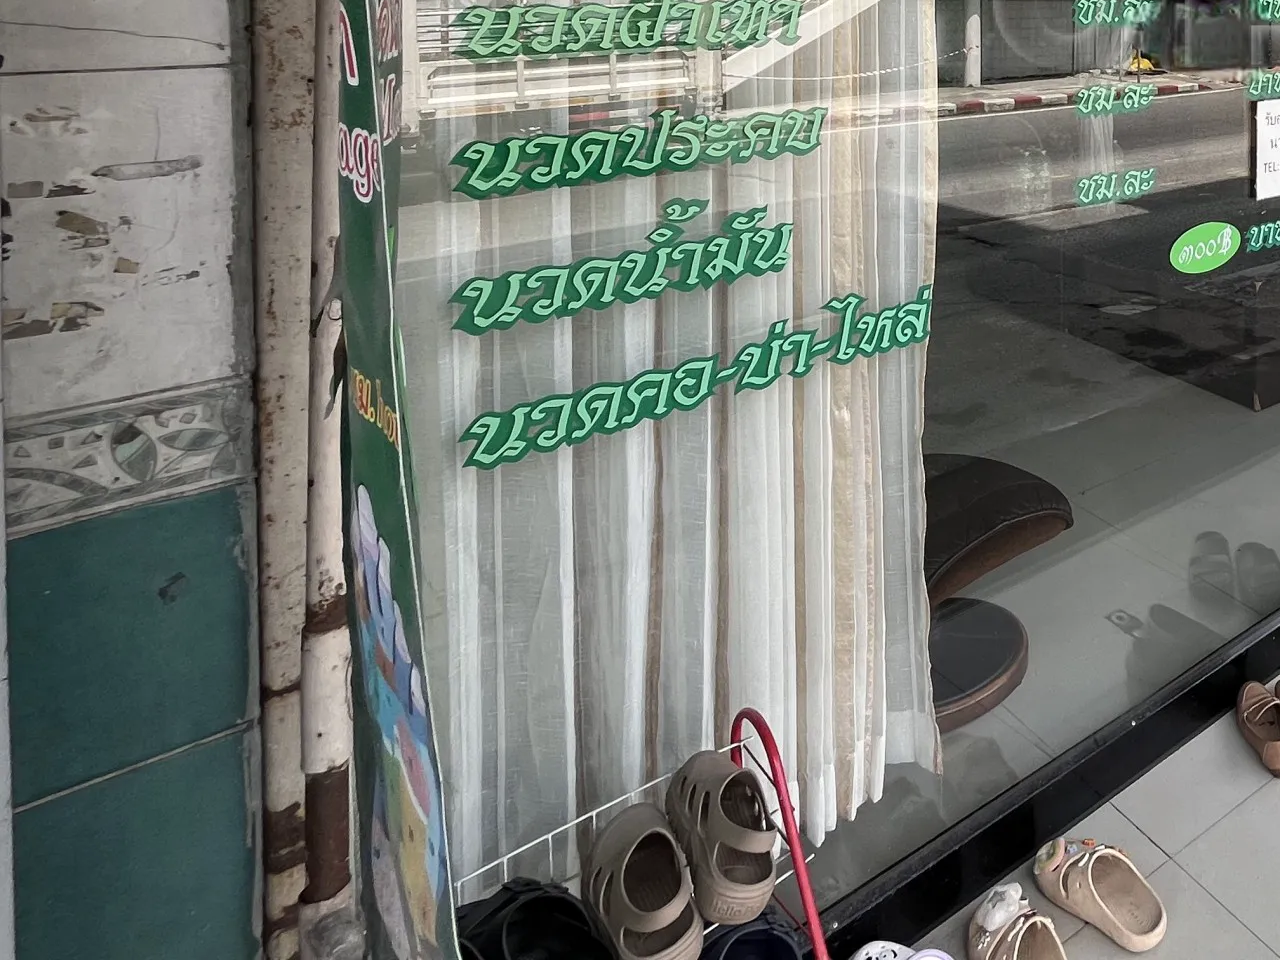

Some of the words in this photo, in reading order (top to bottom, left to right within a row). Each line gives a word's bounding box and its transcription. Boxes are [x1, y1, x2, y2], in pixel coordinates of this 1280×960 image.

[456, 107, 825, 194] นวดประคบ
[1264, 161, 1279, 173] TEL:
[456, 200, 792, 332] นวดน้ำมัน
